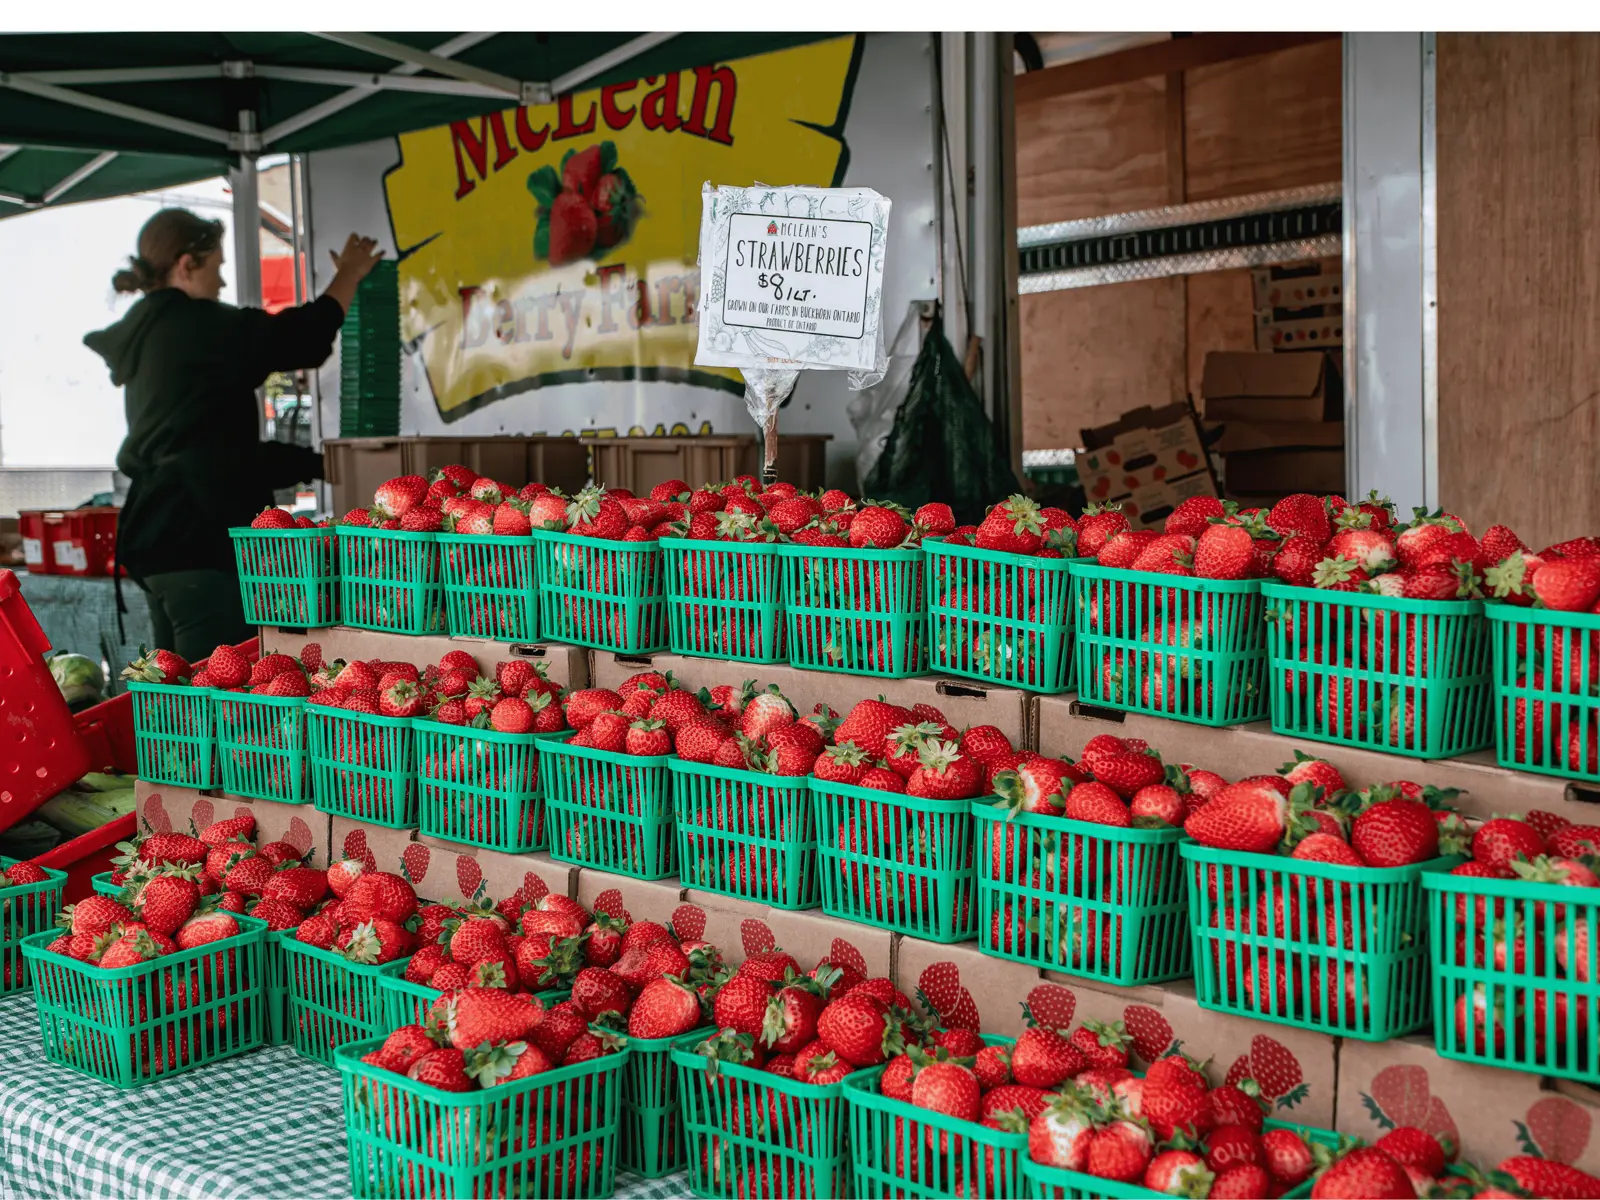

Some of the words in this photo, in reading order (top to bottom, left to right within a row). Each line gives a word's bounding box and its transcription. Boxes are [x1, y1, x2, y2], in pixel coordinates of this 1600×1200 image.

[450, 63, 735, 201] McLean
[781, 223, 828, 239] MCLEAN'S
[736, 239, 864, 277] STRAWBERRIES
[459, 286, 585, 360] Berry
[727, 299, 748, 312] GROWN
[749, 300, 757, 313] ON
[758, 301, 769, 314] OUR
[770, 303, 791, 316] FARMS
[792, 305, 799, 317] IN
[800, 306, 831, 321] BUCKHORN
[833, 309, 861, 323] ONTARIO
[766, 317, 786, 329] PRODUCT
[787, 320, 795, 329] OF
[796, 320, 818, 332] ONTARIO
